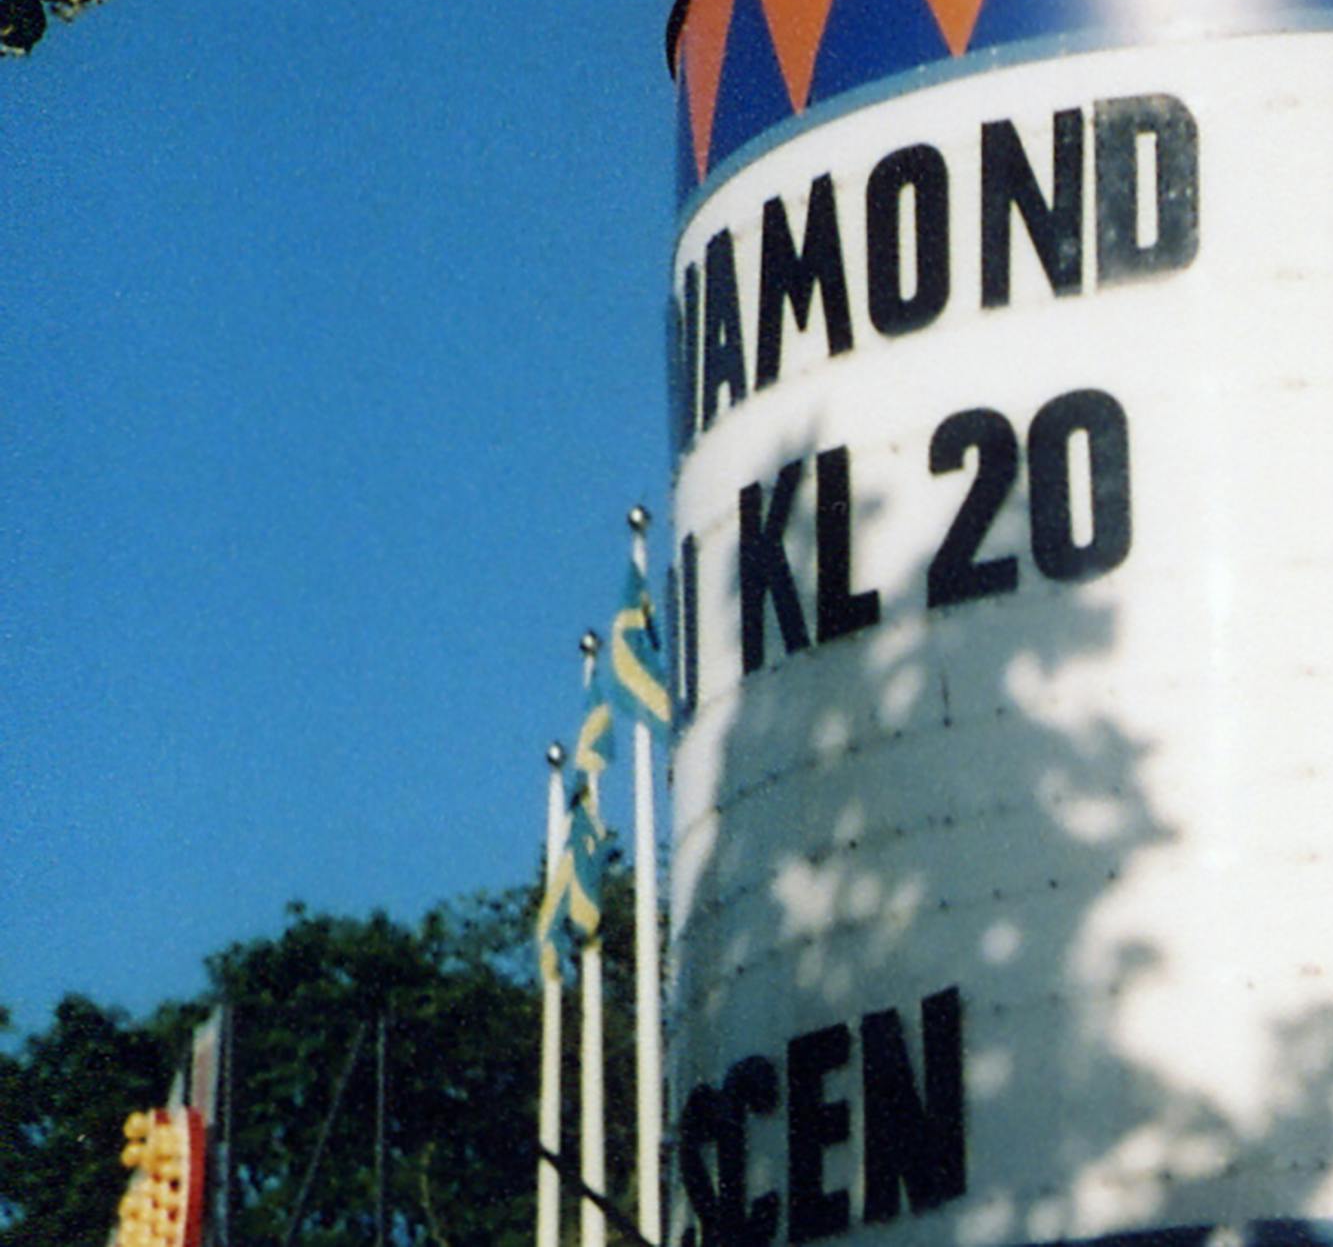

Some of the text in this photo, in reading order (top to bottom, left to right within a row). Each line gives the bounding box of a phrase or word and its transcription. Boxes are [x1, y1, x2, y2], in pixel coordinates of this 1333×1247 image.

[672, 93, 1200, 452] IAMOND
[739, 444, 880, 676] KL
[927, 388, 1133, 610] 20
[680, 985, 967, 1247] SCEN
